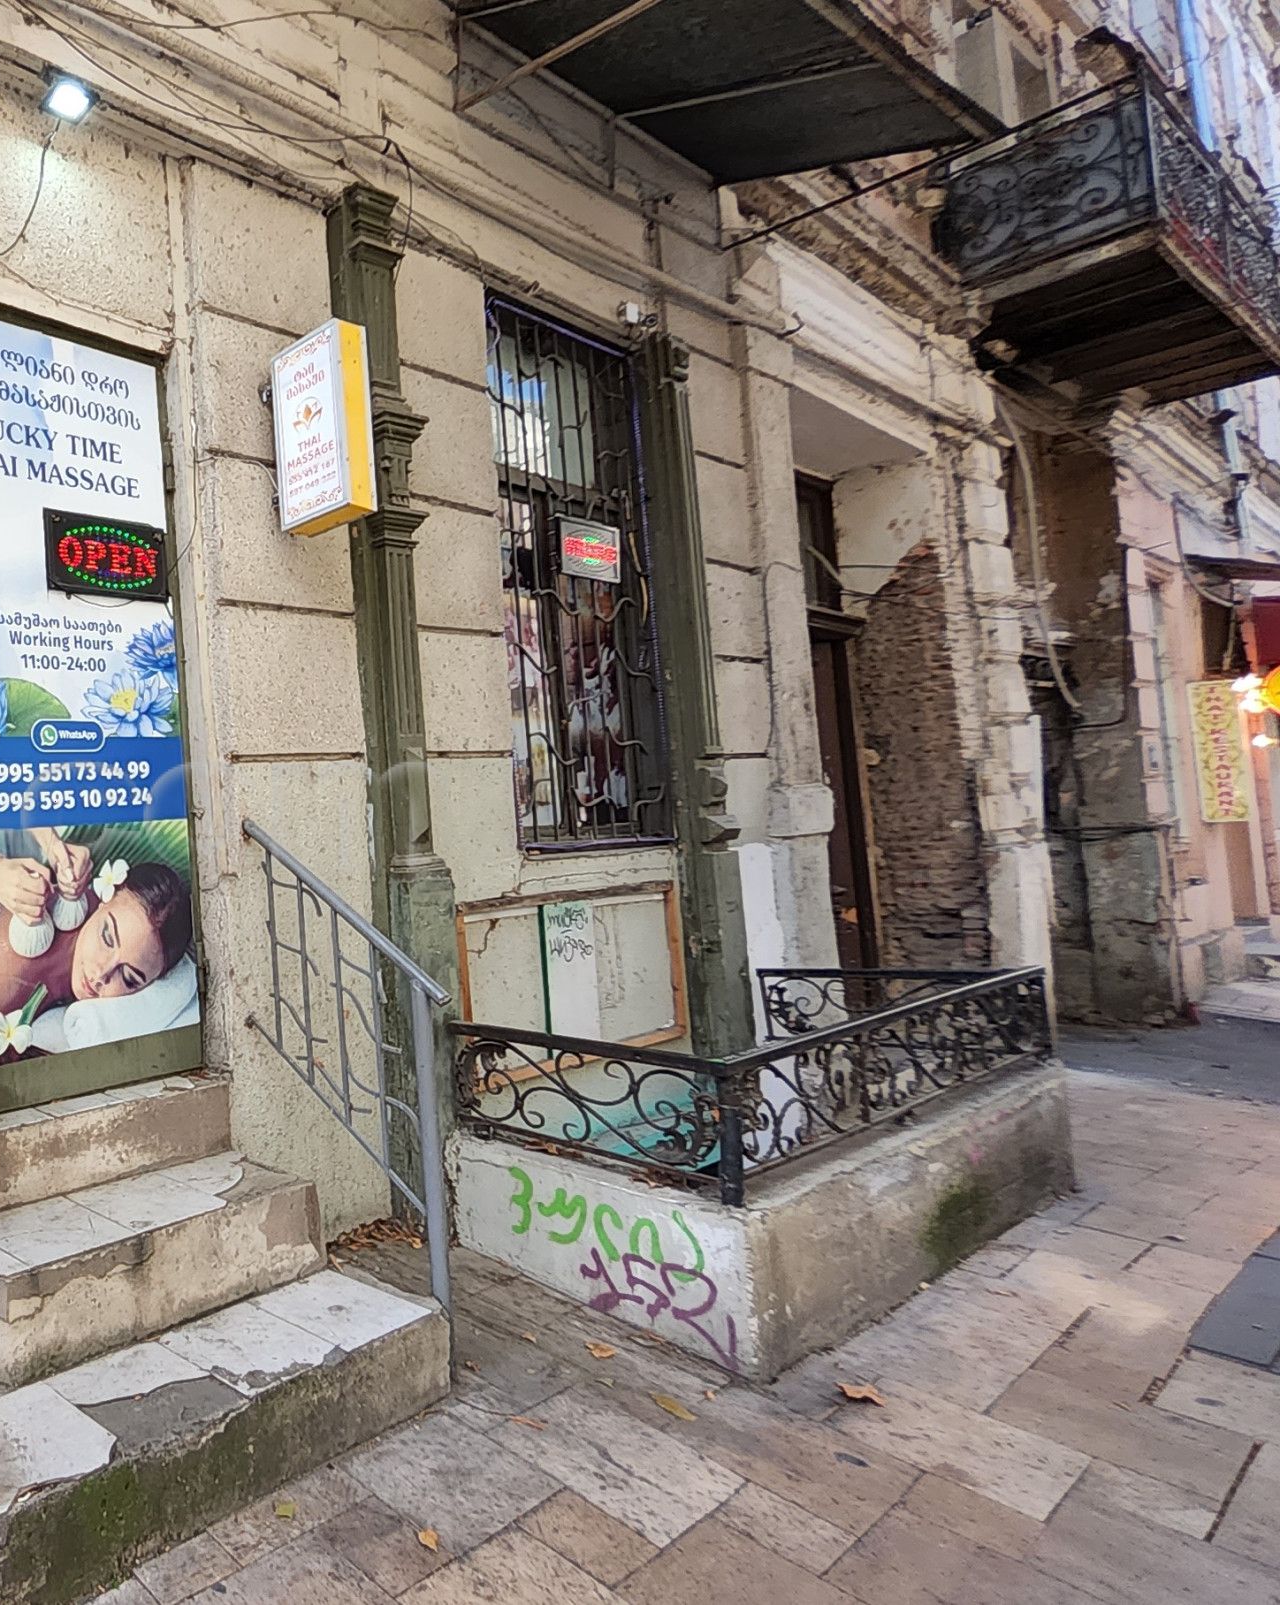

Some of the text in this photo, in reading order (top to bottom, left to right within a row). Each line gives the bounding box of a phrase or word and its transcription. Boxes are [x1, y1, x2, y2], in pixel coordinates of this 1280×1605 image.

[81, 370, 130, 399] დრო
[66, 434, 123, 464] TIME
[297, 433, 321, 452] THAI
[287, 440, 335, 471] MASSAGE
[26, 458, 140, 499] MASSAGE
[58, 535, 159, 578] OPEN
[63, 615, 123, 636] საათები
[8, 630, 114, 652] Working Hours
[20, 653, 107, 673] 11:00-24:00
[58, 729, 98, 741] WhatsApp
[38, 762, 71, 782] 551
[74, 761, 97, 781] 73
[100, 761, 124, 780] 44
[127, 760, 151, 779] 99
[40, 790, 76, 810] 595
[79, 788, 102, 808] 10
[105, 787, 128, 807] 92
[131, 786, 153, 806] 24
